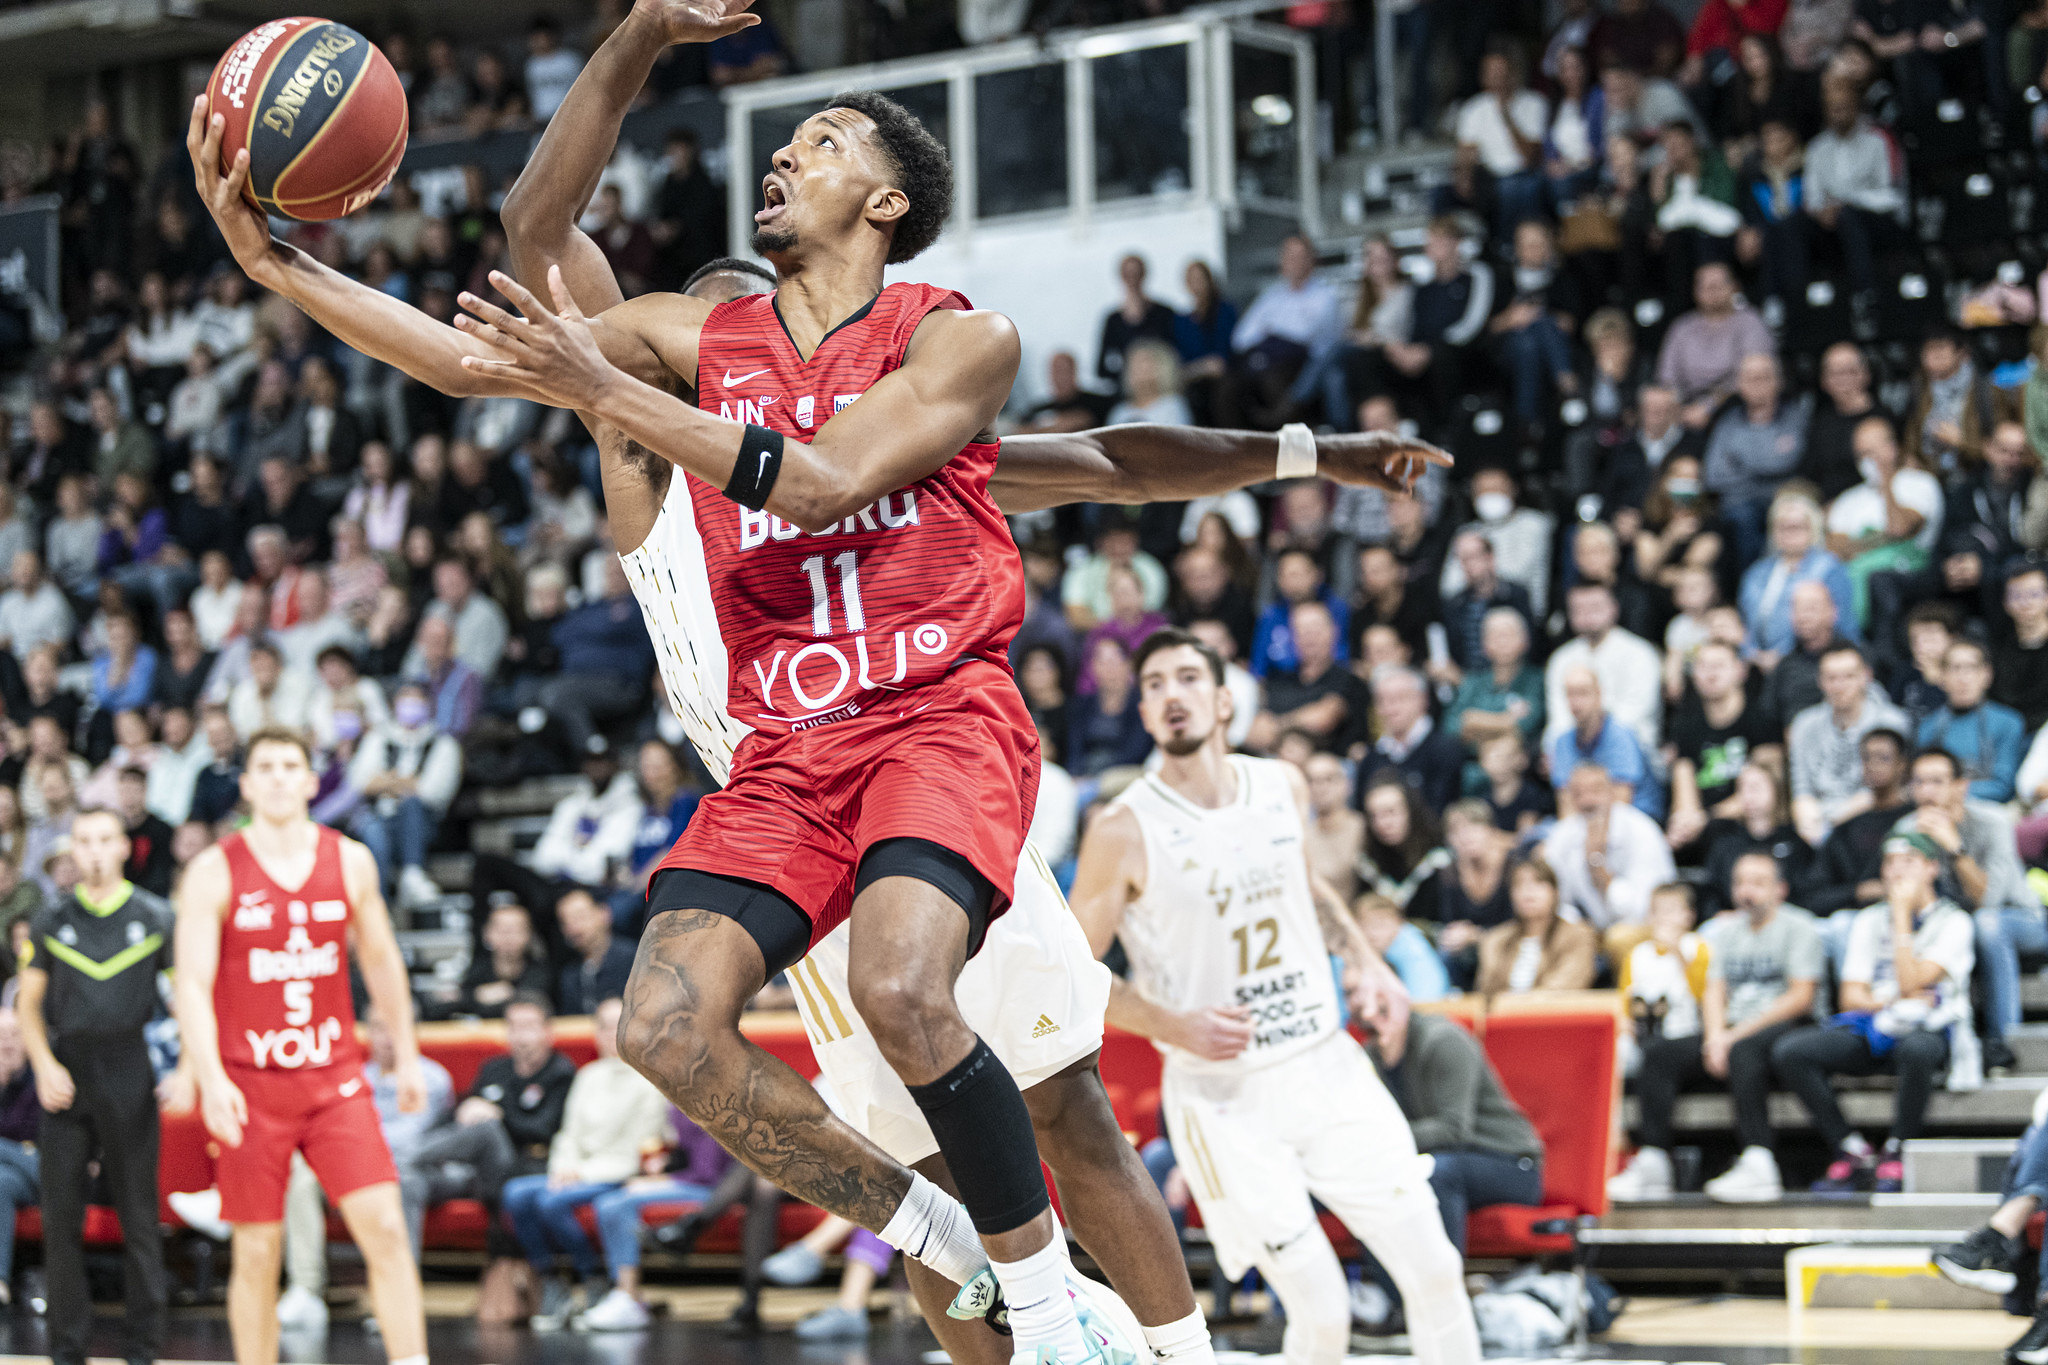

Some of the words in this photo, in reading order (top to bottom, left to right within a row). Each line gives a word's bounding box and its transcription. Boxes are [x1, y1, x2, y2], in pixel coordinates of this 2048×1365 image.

[739, 490, 921, 551] BORG
[801, 549, 867, 638] 11
[753, 631, 908, 711] YOU
[791, 700, 862, 733] CUISINE
[1231, 917, 1282, 977] 12
[283, 980, 314, 1026] 5
[1235, 970, 1306, 1006] SMART
[245, 1023, 332, 1069] YOU
[1032, 1025, 1061, 1039] adidas
